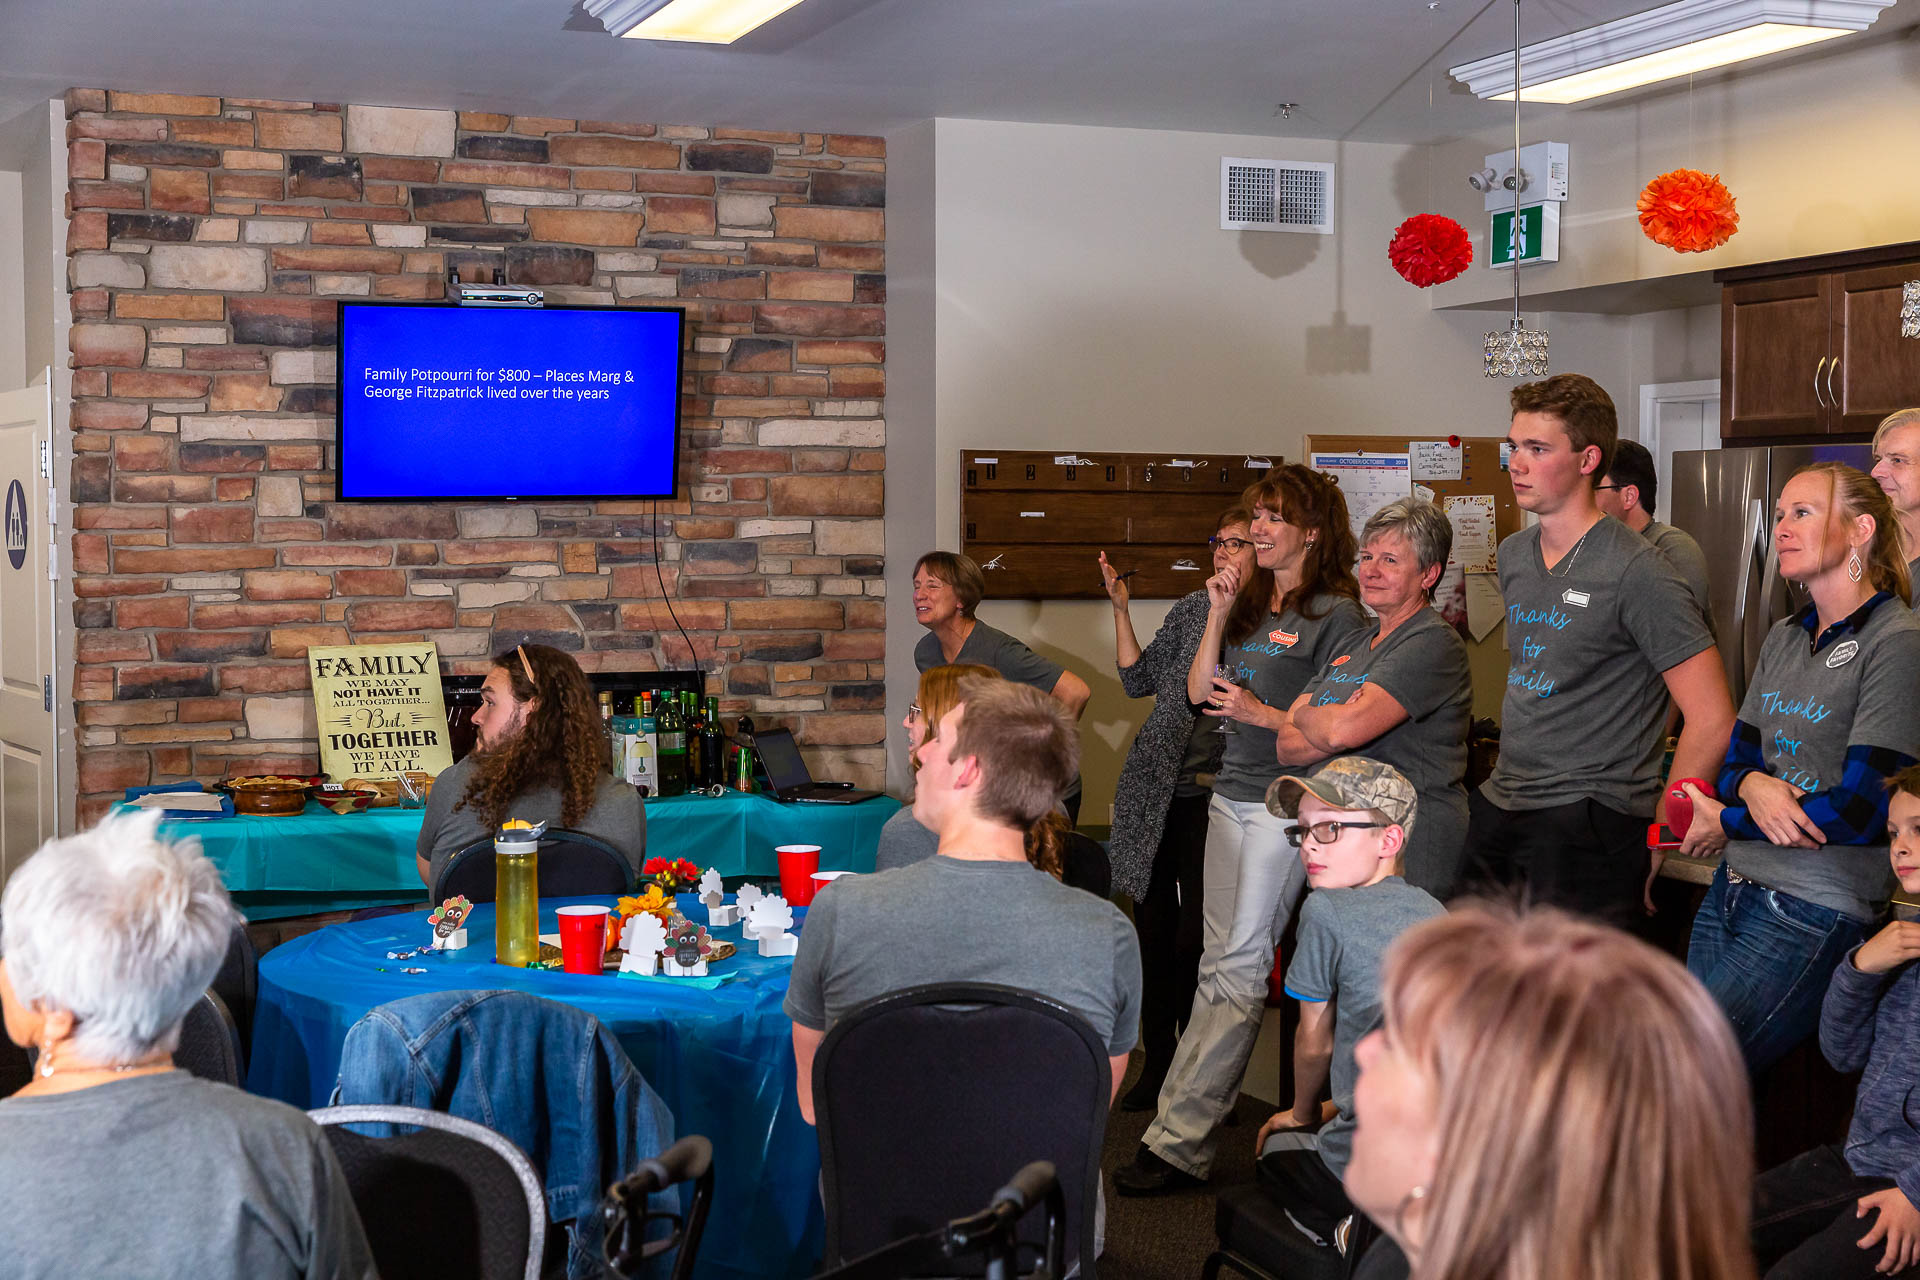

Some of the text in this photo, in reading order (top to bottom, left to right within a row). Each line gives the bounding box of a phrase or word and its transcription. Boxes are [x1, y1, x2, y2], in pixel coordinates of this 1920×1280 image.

[364, 367, 407, 383] Family
[411, 368, 473, 383] Potpourri
[476, 369, 495, 381] for
[498, 369, 530, 383] $800
[545, 370, 585, 383] Places
[588, 370, 621, 385] Marg
[624, 371, 635, 383] &
[364, 386, 610, 402] George Fitzpatrick lived over the years
[1508, 603, 1572, 630] Thanks
[1272, 632, 1298, 643] COUSINS
[1229, 642, 1286, 657] anks
[1522, 635, 1547, 663] for
[315, 650, 434, 679] FAMILY
[346, 678, 410, 688] WE MAY
[333, 687, 422, 699] NOT HAVE IT
[333, 699, 356, 707] ALL
[1761, 690, 1832, 724] Thanks
[328, 730, 438, 750] TOGETHER
[1774, 729, 1802, 759] for
[349, 749, 420, 761] WE HAVE
[353, 760, 424, 774] IT ALL.
